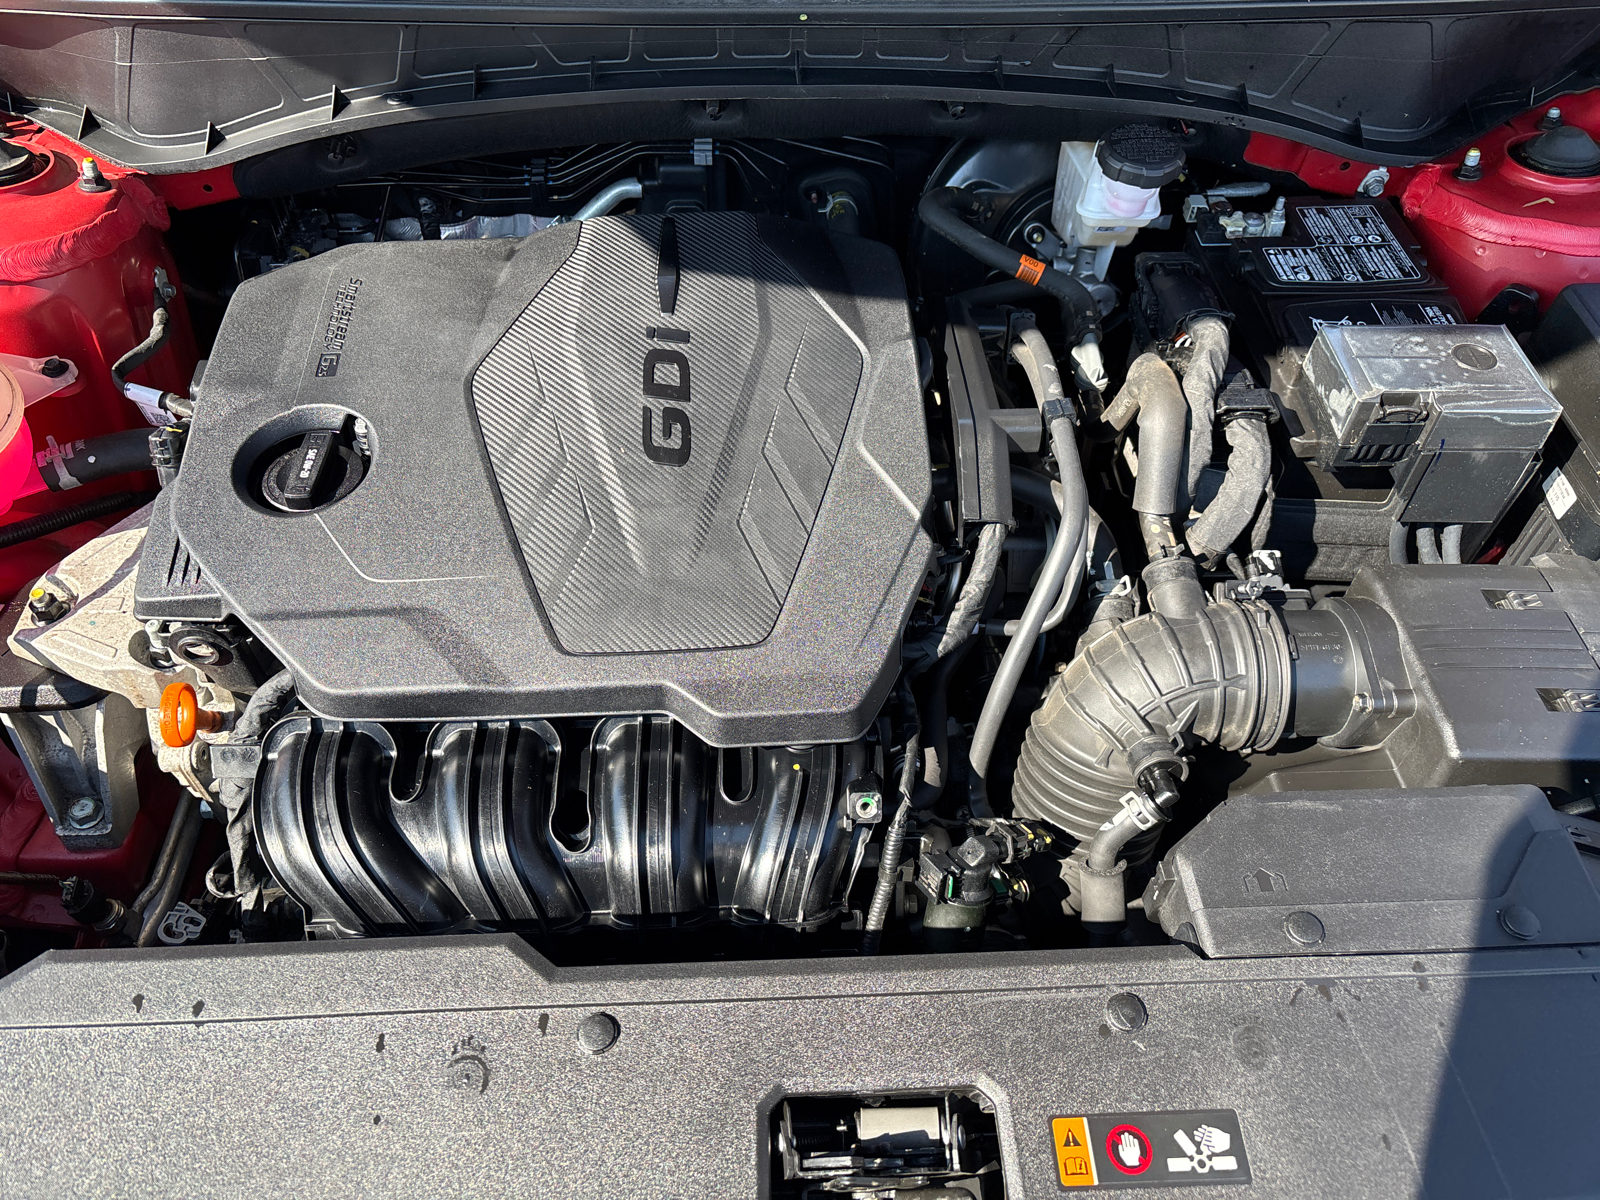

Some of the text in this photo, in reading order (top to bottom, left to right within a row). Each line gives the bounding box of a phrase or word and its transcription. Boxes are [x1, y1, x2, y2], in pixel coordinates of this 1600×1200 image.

[323, 285, 347, 350] TECHNOLOGY
[332, 276, 363, 351] Smartstream
[642, 325, 692, 468] GDi
[299, 449, 318, 478] SAE 0W-20
[163, 691, 174, 734] ENGINE OIL
